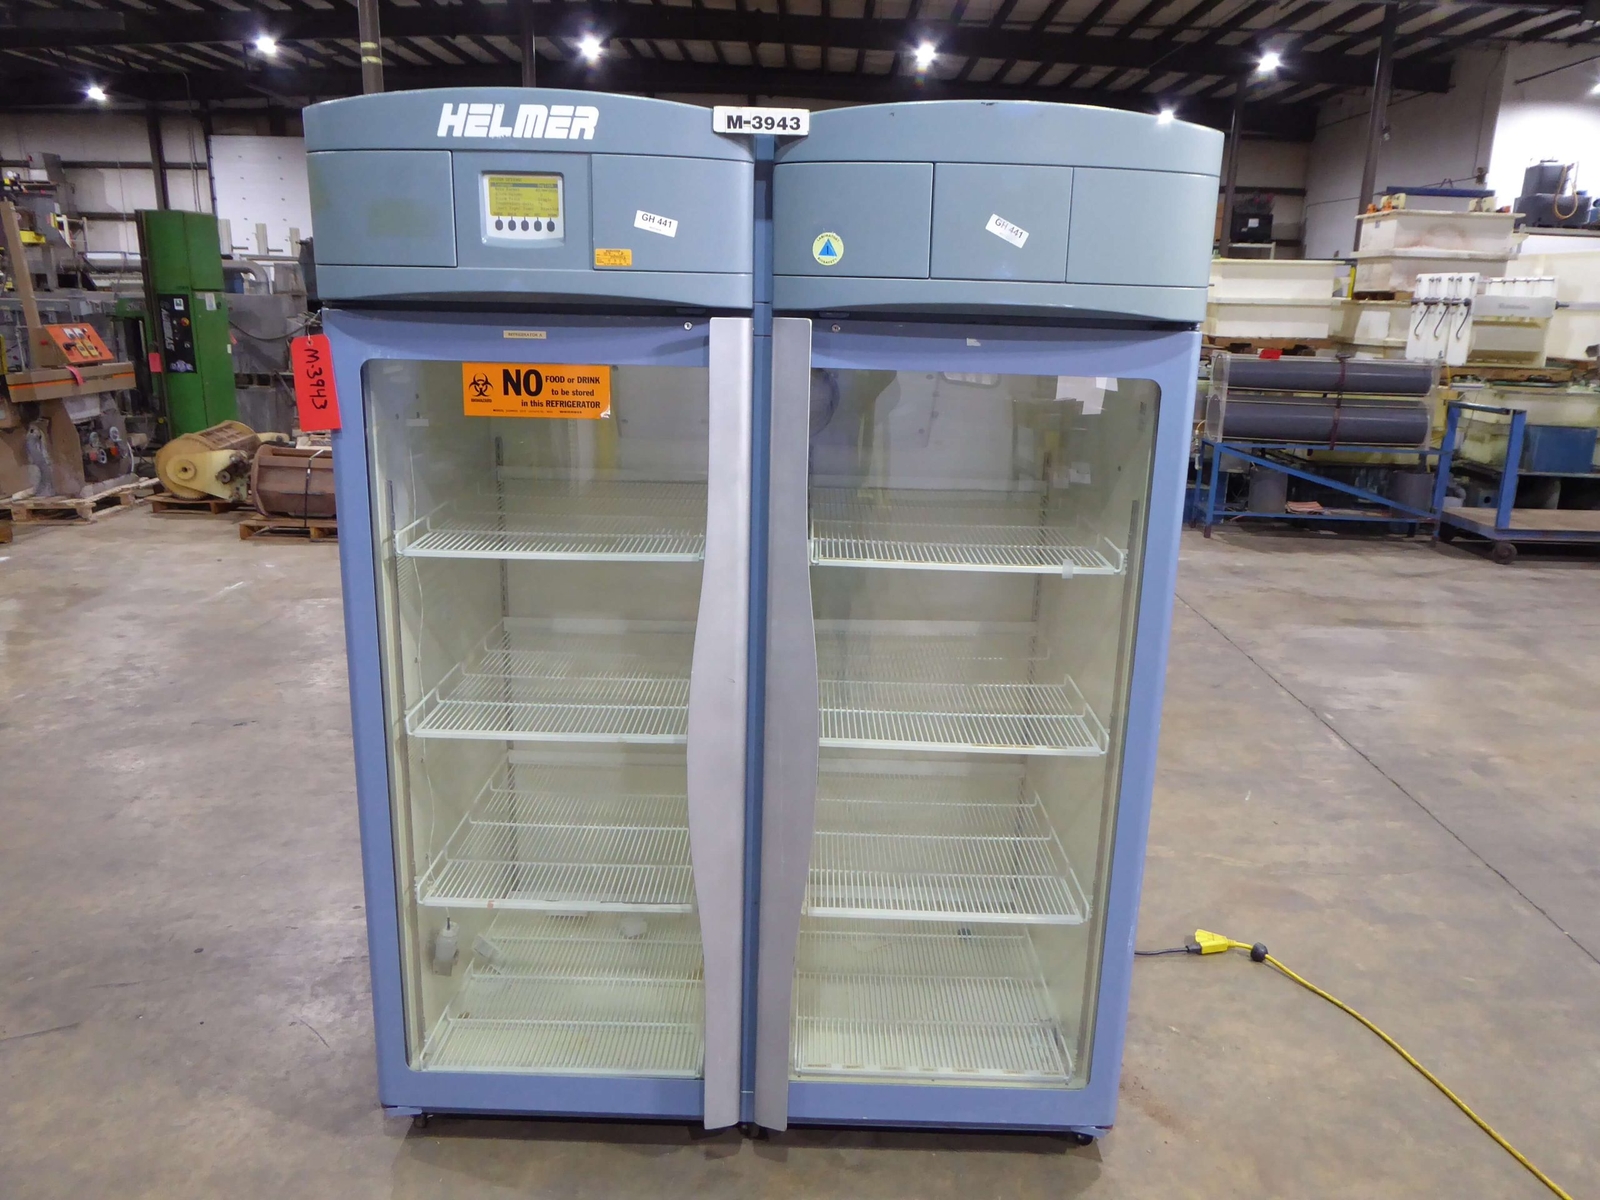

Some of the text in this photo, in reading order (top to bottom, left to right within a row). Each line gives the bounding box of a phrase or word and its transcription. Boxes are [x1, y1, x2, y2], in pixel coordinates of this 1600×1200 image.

[437, 103, 600, 140] HELMER
[727, 115, 801, 131] M-3943
[642, 213, 672, 228] GH 441
[995, 218, 1023, 239] GH 441
[502, 368, 543, 397] NO
[545, 375, 565, 384] FOOD
[577, 376, 600, 384] DRINK
[561, 388, 570, 396] be
[571, 388, 594, 397] stored
[521, 399, 600, 409] in this REFRIGERATOR
